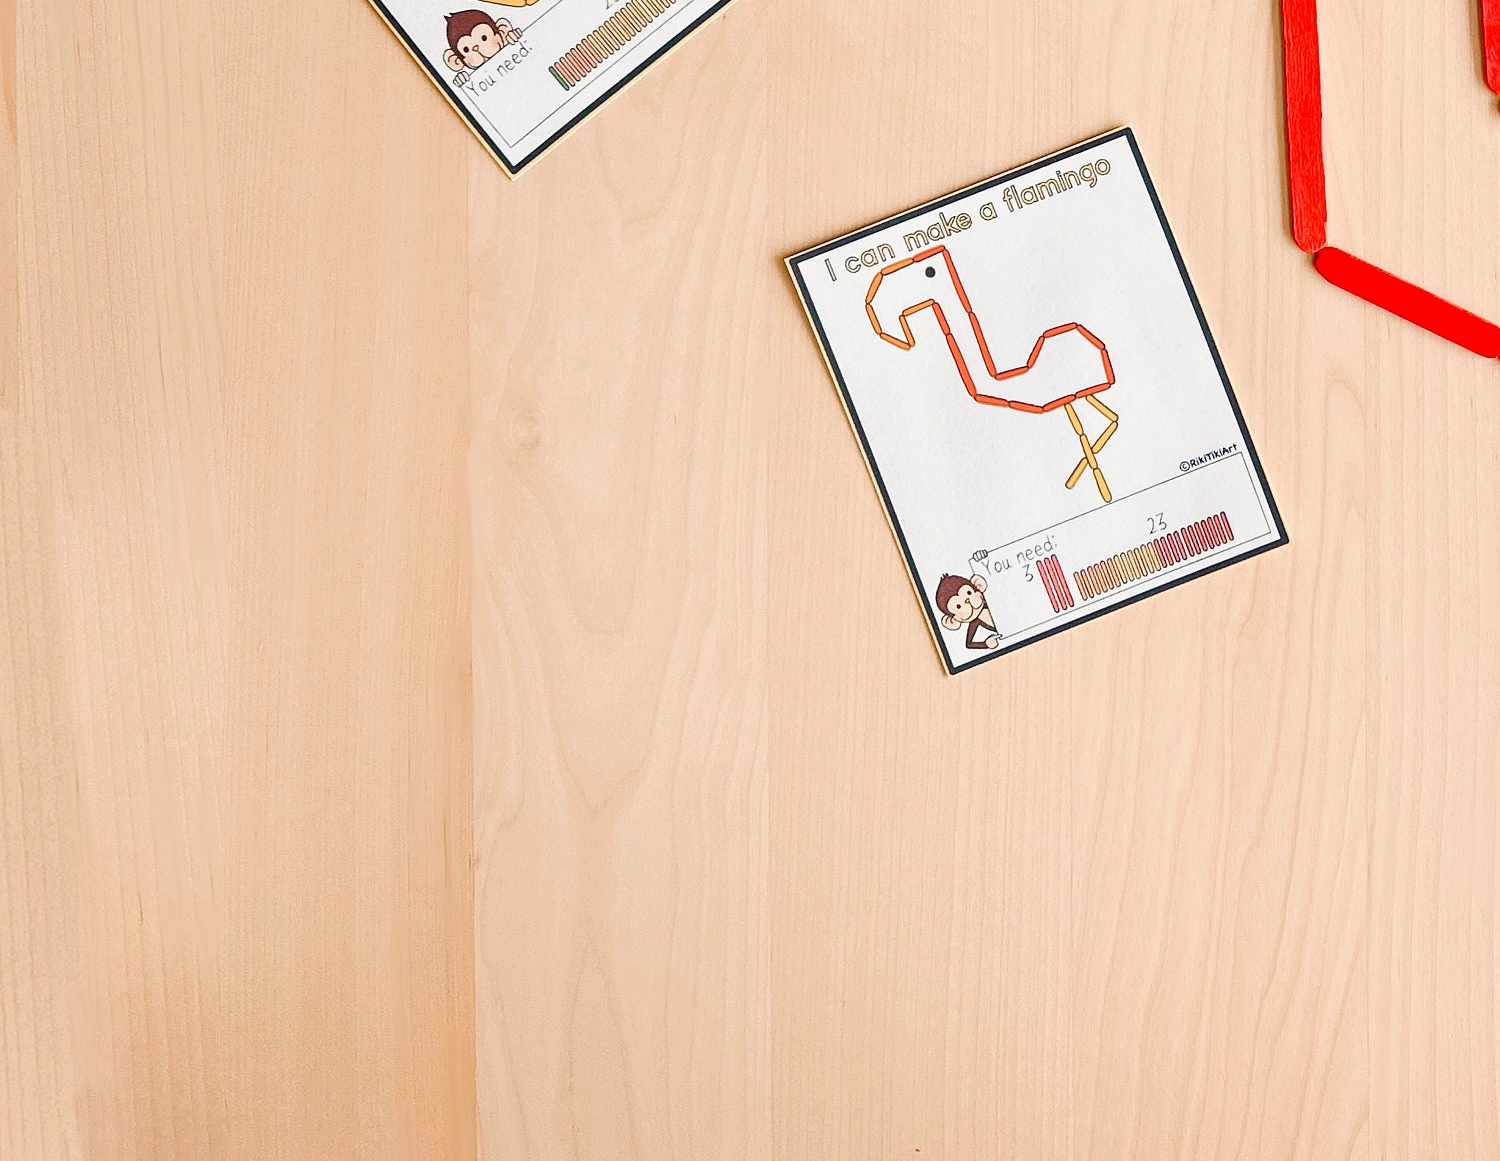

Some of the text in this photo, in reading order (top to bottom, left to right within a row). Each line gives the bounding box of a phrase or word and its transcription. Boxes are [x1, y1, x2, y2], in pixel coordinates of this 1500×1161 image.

[465, 39, 533, 98] You need:
[825, 158, 1110, 281] I can make a flamingo
[1146, 512, 1168, 535] 23
[981, 535, 1058, 578] You need:
[1023, 565, 1034, 583] 3
